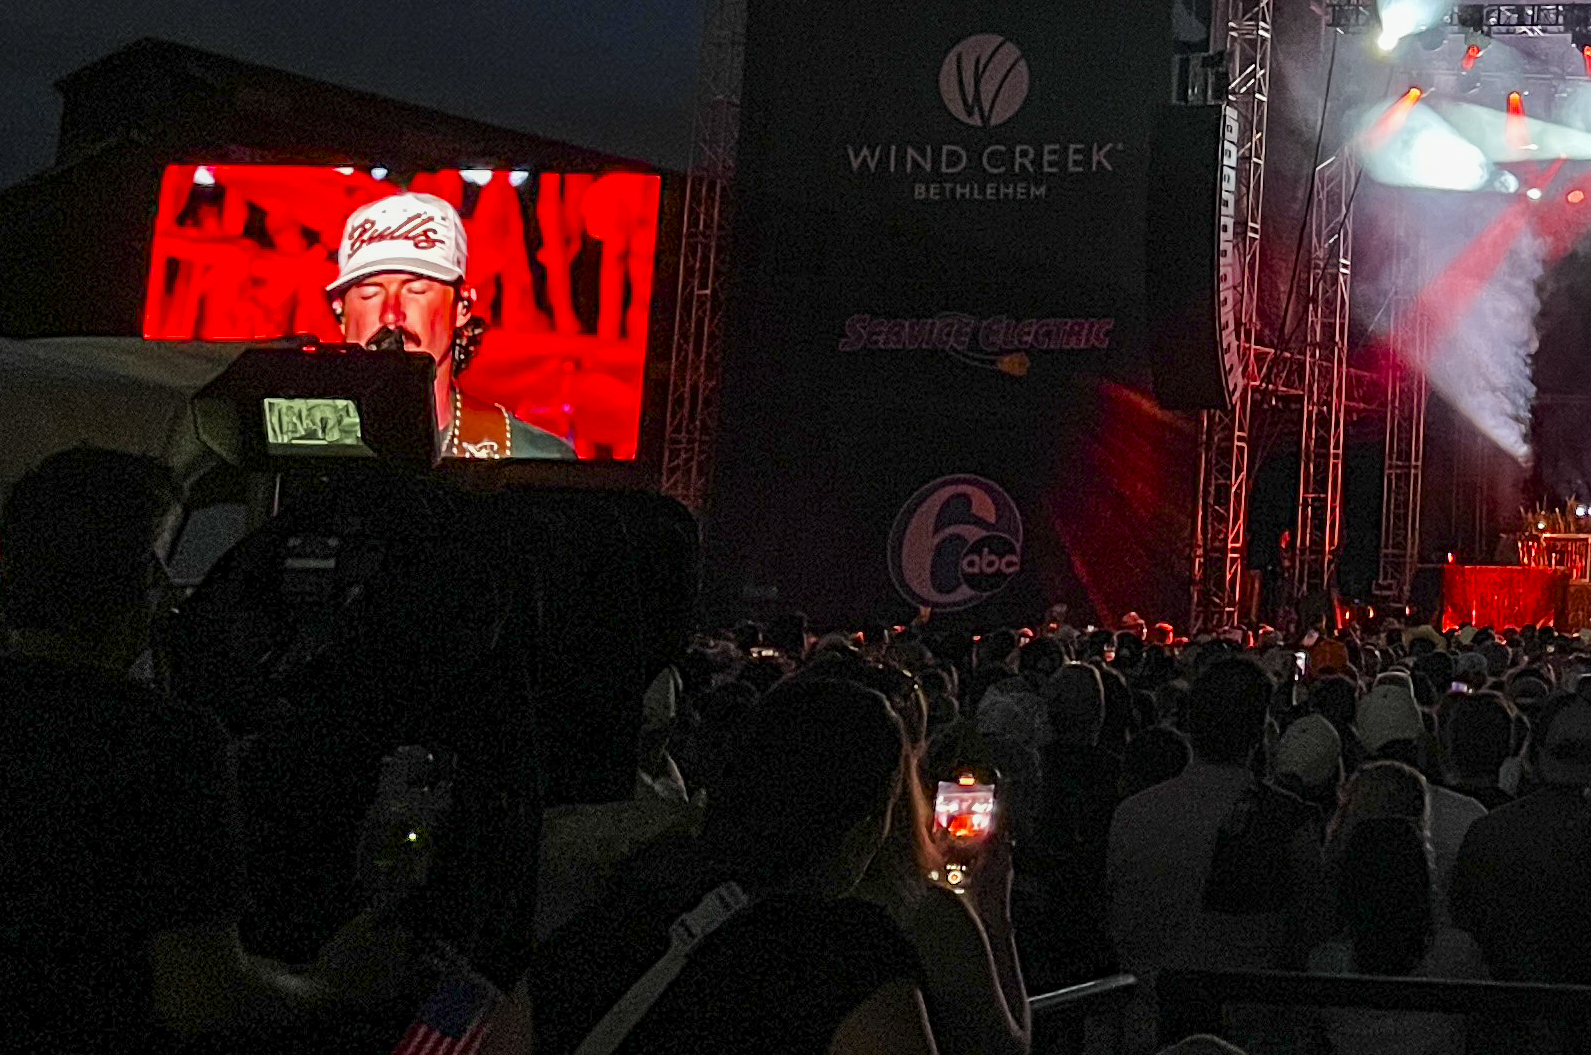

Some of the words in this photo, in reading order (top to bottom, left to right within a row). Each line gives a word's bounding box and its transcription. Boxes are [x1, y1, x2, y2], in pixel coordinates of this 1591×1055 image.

[847, 144, 967, 174] WIND
[982, 142, 1115, 175] CREEK
[914, 183, 1047, 201] BETHLEHEM
[348, 212, 446, 260] Bulls
[901, 483, 998, 604] 6
[961, 547, 1020, 575] abc
